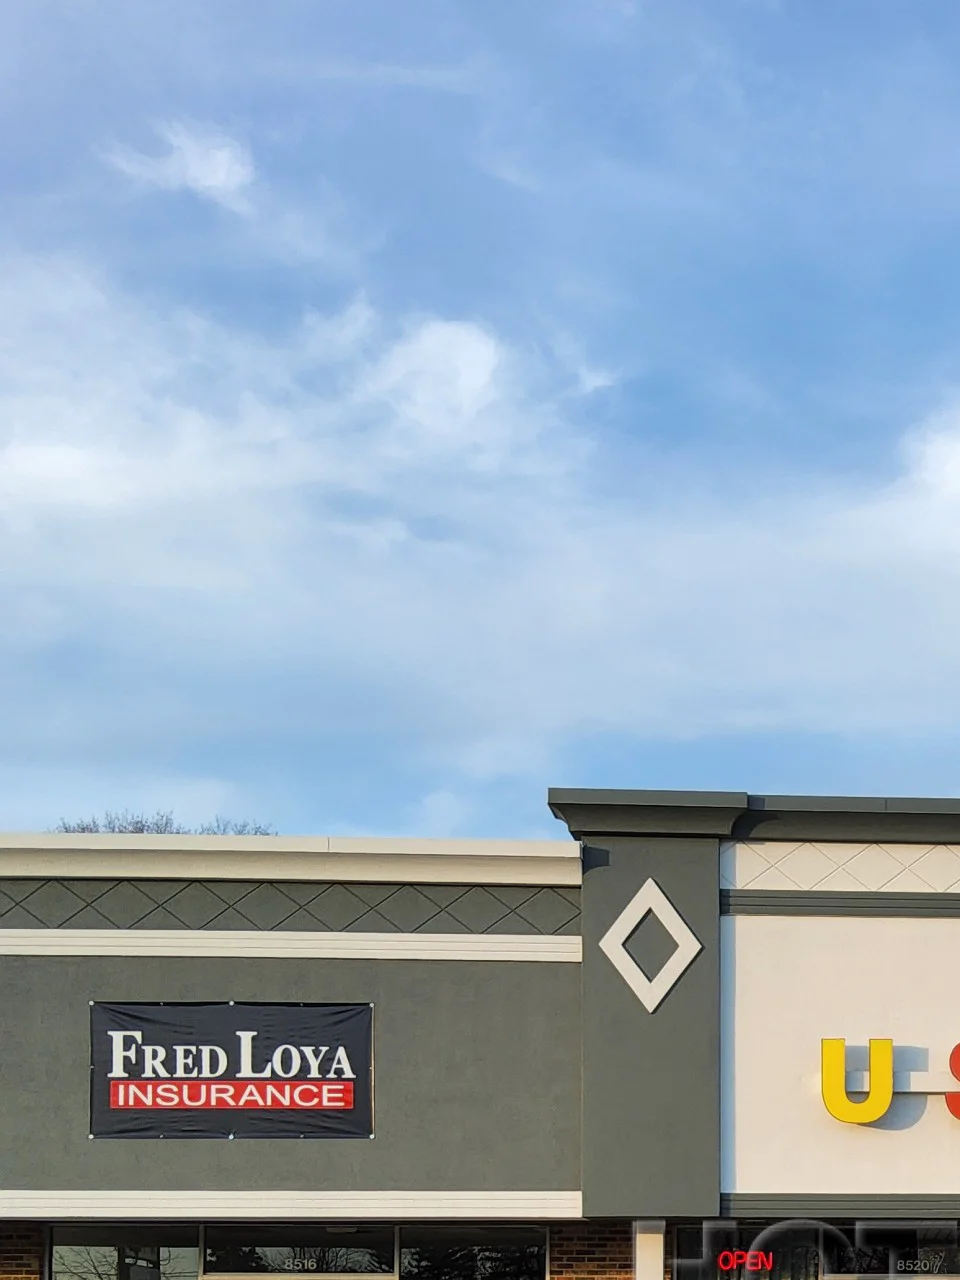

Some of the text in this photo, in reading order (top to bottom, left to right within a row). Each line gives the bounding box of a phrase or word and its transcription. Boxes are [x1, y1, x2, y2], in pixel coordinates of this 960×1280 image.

[821, 1038, 894, 1124] U
[117, 1084, 346, 1107] INSURANCE
[284, 1258, 317, 1270] 8516
[717, 1251, 773, 1271] OPEN
[896, 1259, 931, 1271] 8520
